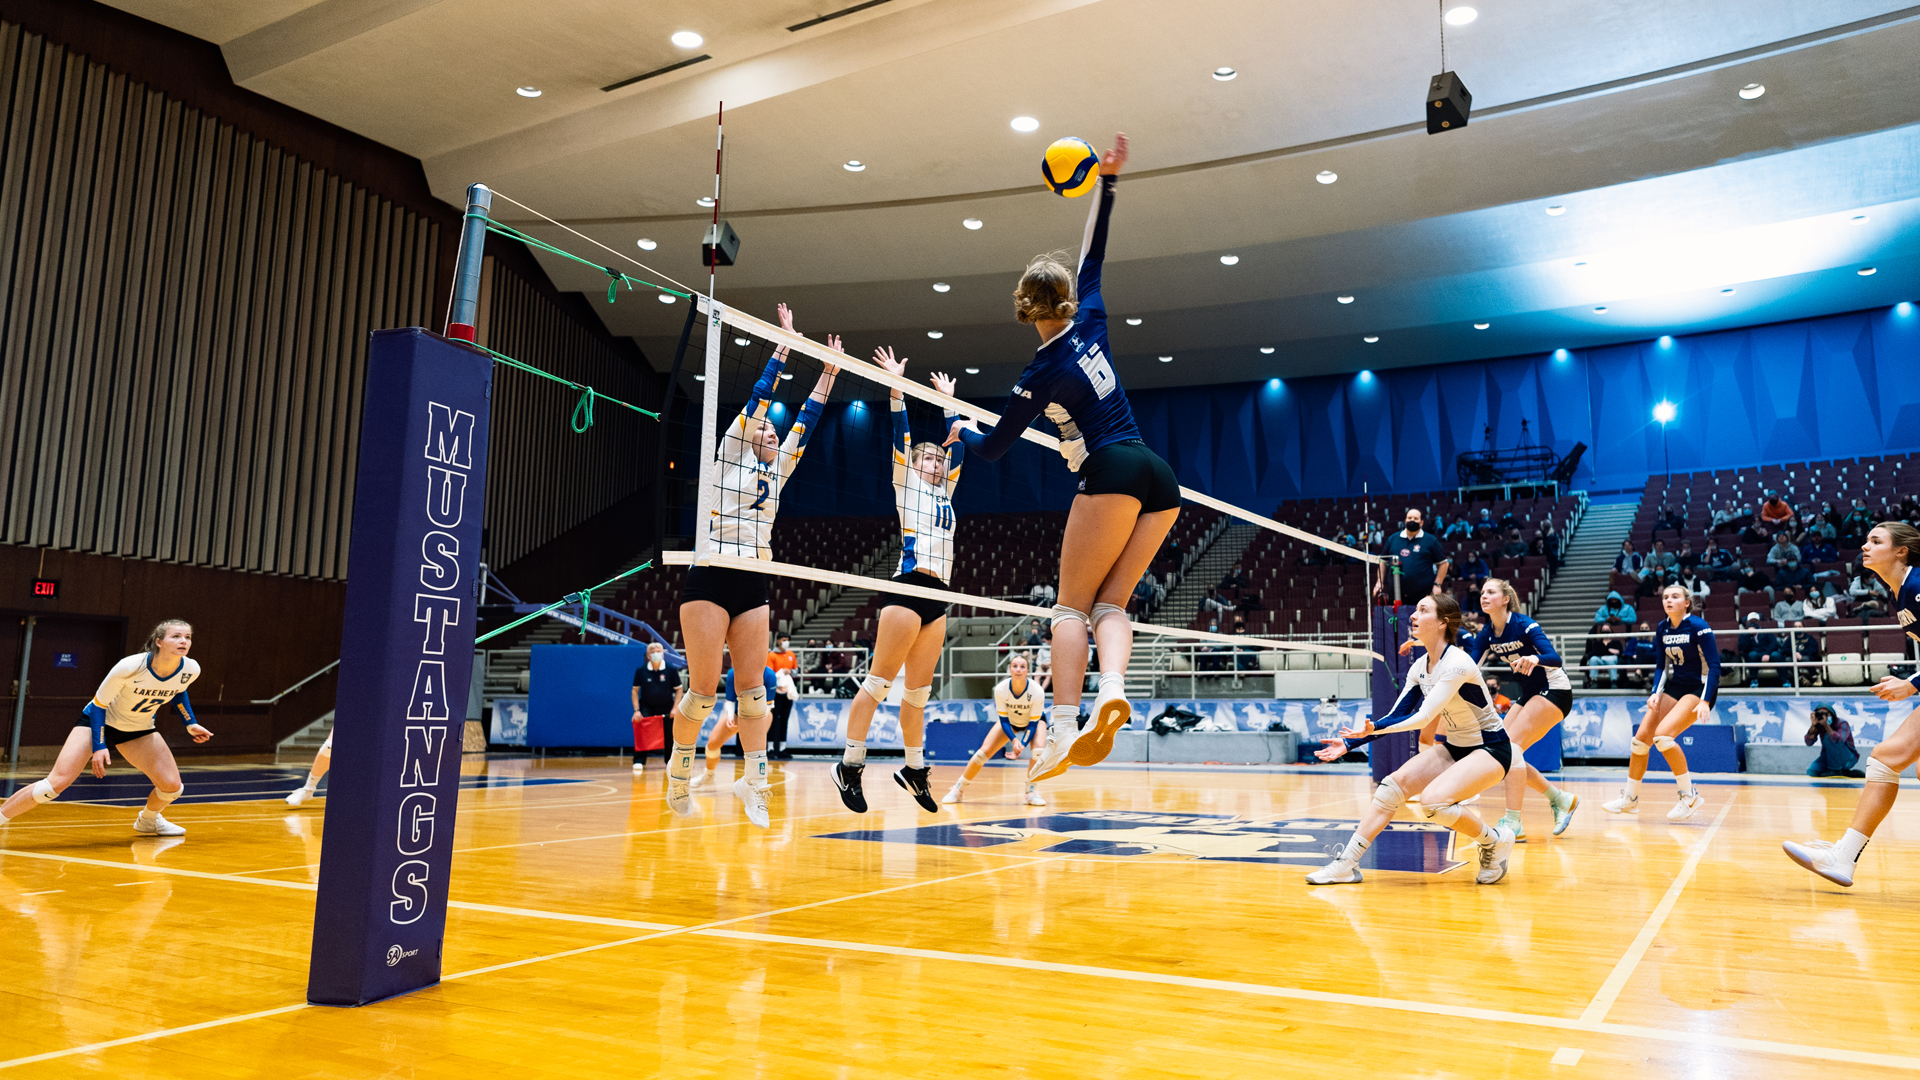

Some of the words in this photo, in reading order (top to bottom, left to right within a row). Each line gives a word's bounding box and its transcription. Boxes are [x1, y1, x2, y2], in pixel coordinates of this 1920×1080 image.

[1077, 343, 1117, 400] 6
[748, 479, 770, 512] 2
[935, 503, 953, 531] 10
[34, 582, 56, 596] EXIT
[542, 606, 629, 645] ww.westermustangs.ca
[1662, 634, 1690, 645] WESTERN
[1489, 640, 1524, 654] WESTERN
[389, 401, 475, 925] MUSTANGS
[130, 698, 166, 713] 12
[502, 728, 527, 738] MUSTA
[800, 729, 837, 740] MUSTANGS
[867, 730, 895, 741] STANGS
[402, 948, 419, 959] SPORT
